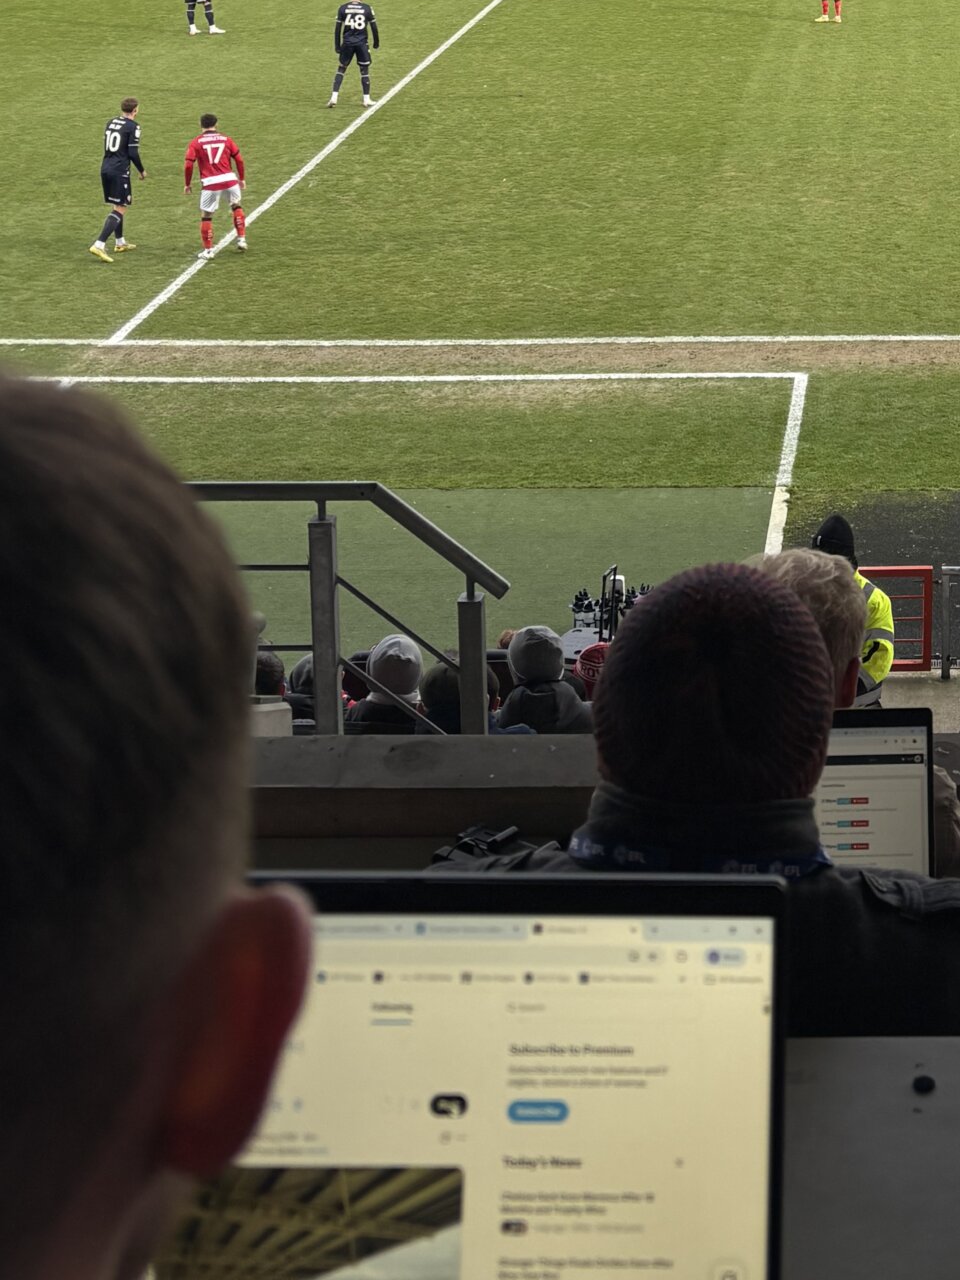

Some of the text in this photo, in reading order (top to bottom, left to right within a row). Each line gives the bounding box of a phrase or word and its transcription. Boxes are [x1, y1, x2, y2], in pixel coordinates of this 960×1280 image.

[344, 13, 366, 30] 48
[105, 130, 121, 152] 10
[202, 142, 226, 165] 17
